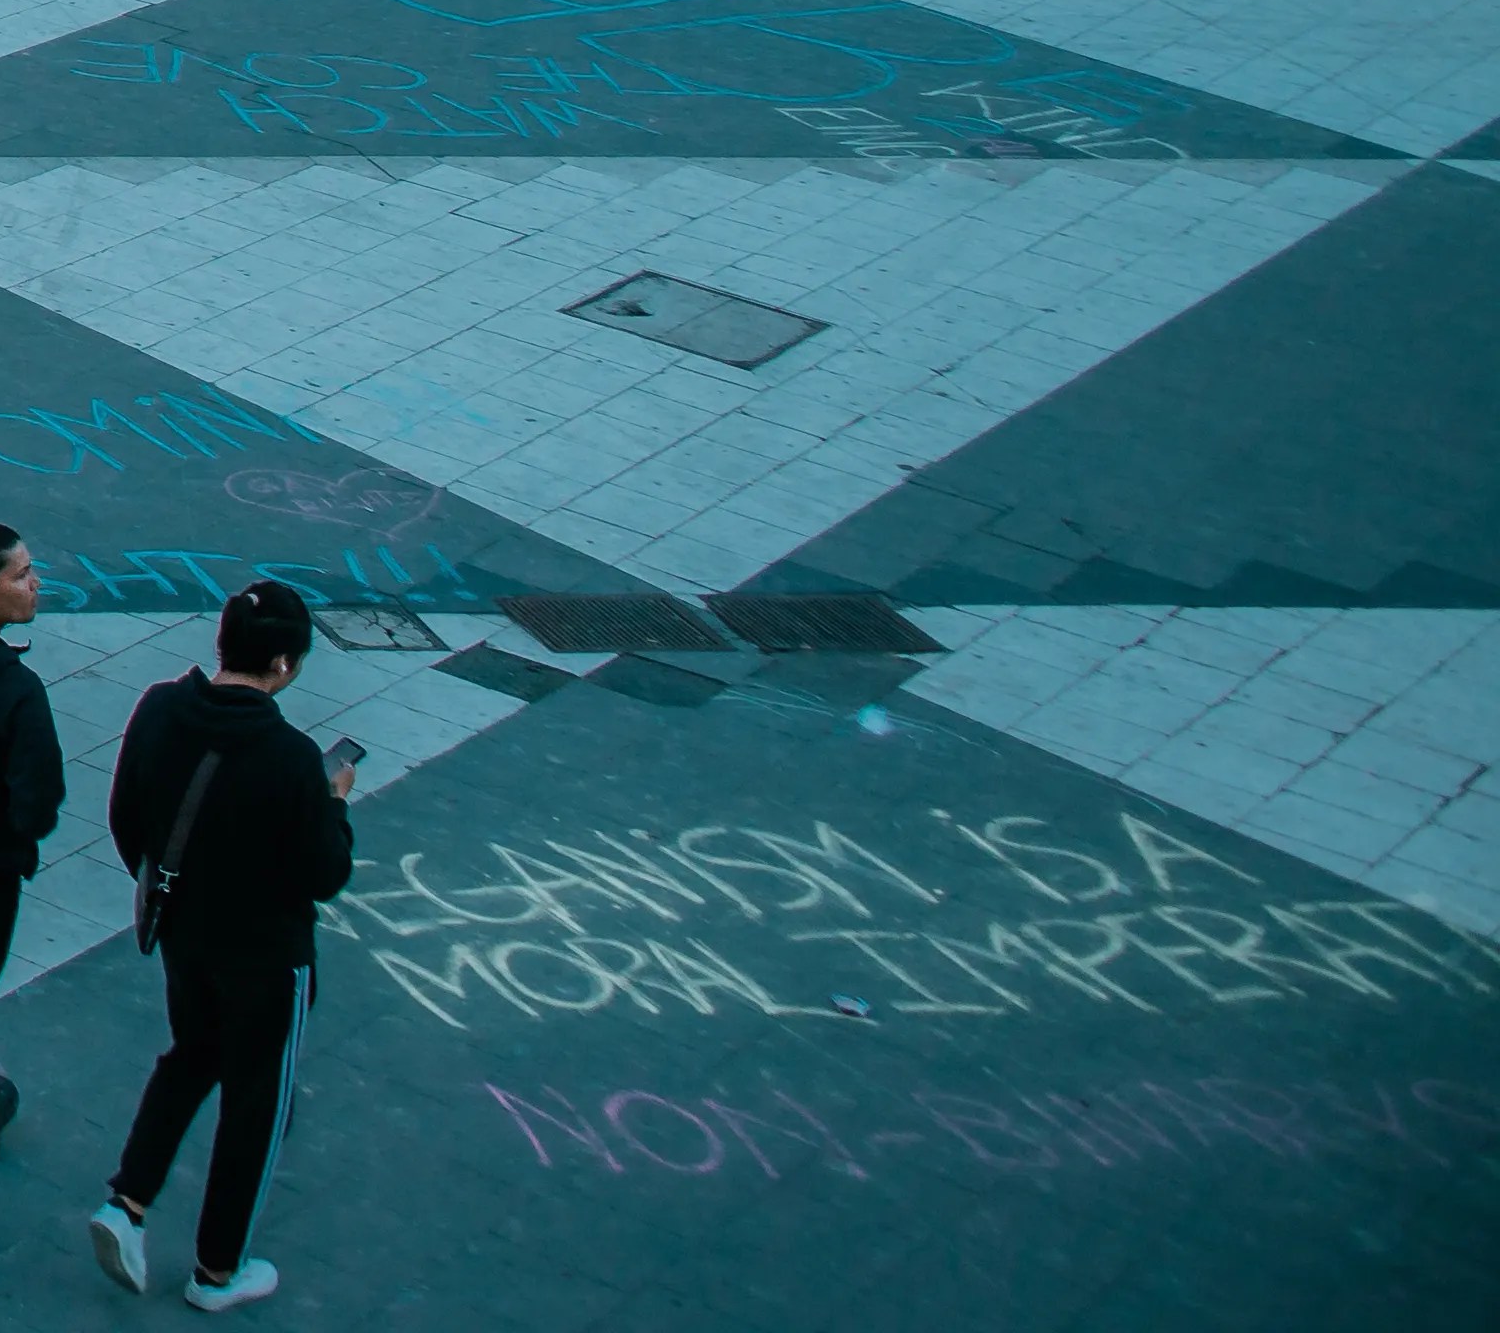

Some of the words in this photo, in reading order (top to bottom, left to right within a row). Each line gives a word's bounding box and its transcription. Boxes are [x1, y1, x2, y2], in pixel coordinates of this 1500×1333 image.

[69, 38, 428, 90] COVE
[217, 88, 666, 138] WATCH
[929, 807, 1123, 904] IS
[1119, 810, 1262, 890] A
[370, 938, 879, 1030] MORAL
